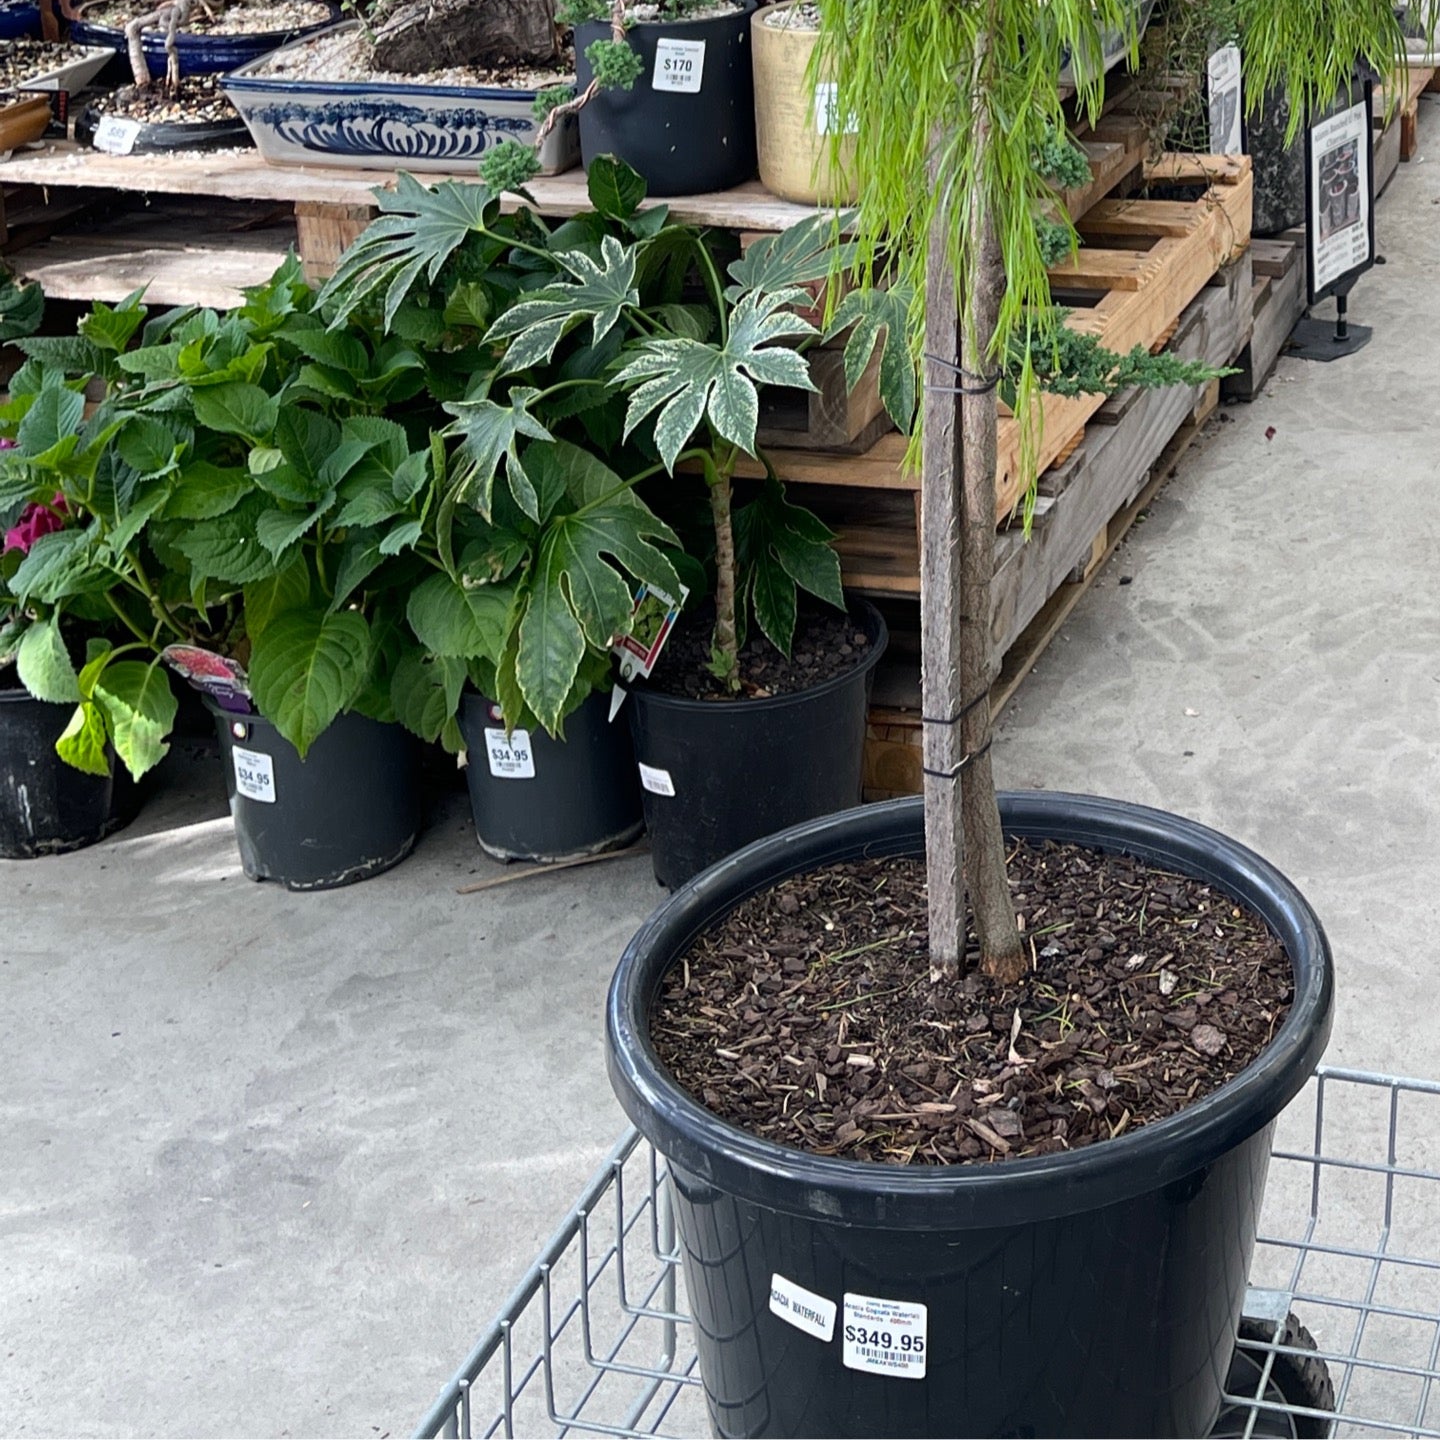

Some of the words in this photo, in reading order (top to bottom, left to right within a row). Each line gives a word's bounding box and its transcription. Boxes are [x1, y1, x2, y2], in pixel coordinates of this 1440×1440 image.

[663, 58, 693, 72] $170
[491, 747, 529, 762] $34.95
[237, 766, 270, 786] $34.95
[793, 1303, 826, 1327] WATERFALL
[845, 1326, 924, 1352] $349.95
